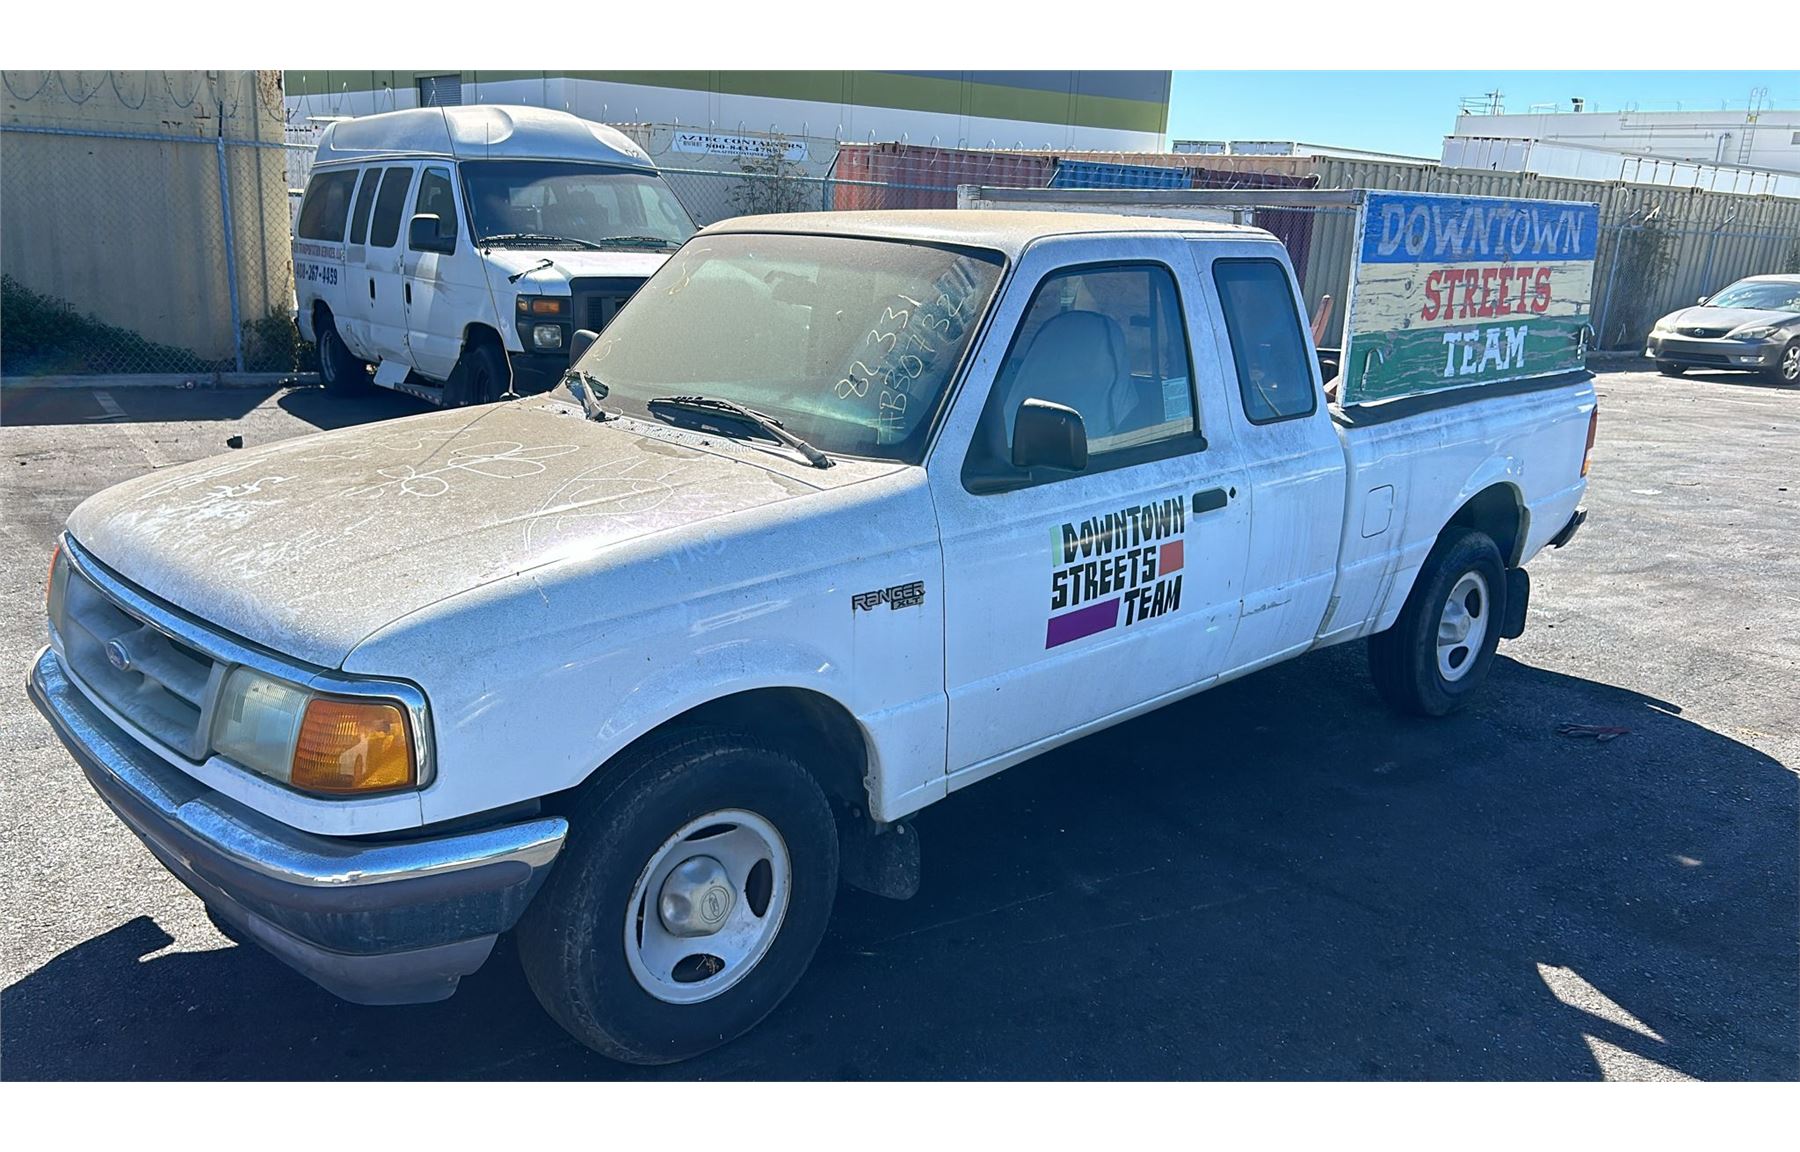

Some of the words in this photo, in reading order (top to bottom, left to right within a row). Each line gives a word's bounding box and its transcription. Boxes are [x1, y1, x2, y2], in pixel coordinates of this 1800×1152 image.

[680, 133, 718, 143] AZTEC
[724, 139, 803, 149] CONTAINRS
[1376, 202, 1585, 256] DOWNTOWN
[1421, 267, 1552, 321] STREETS
[1442, 325, 1528, 378] TEAM
[1062, 495, 1185, 564] DOWNTOWN
[852, 580, 926, 611] RANGER
[1051, 545, 1157, 611] STREETS
[1124, 574, 1183, 627] TEAM
